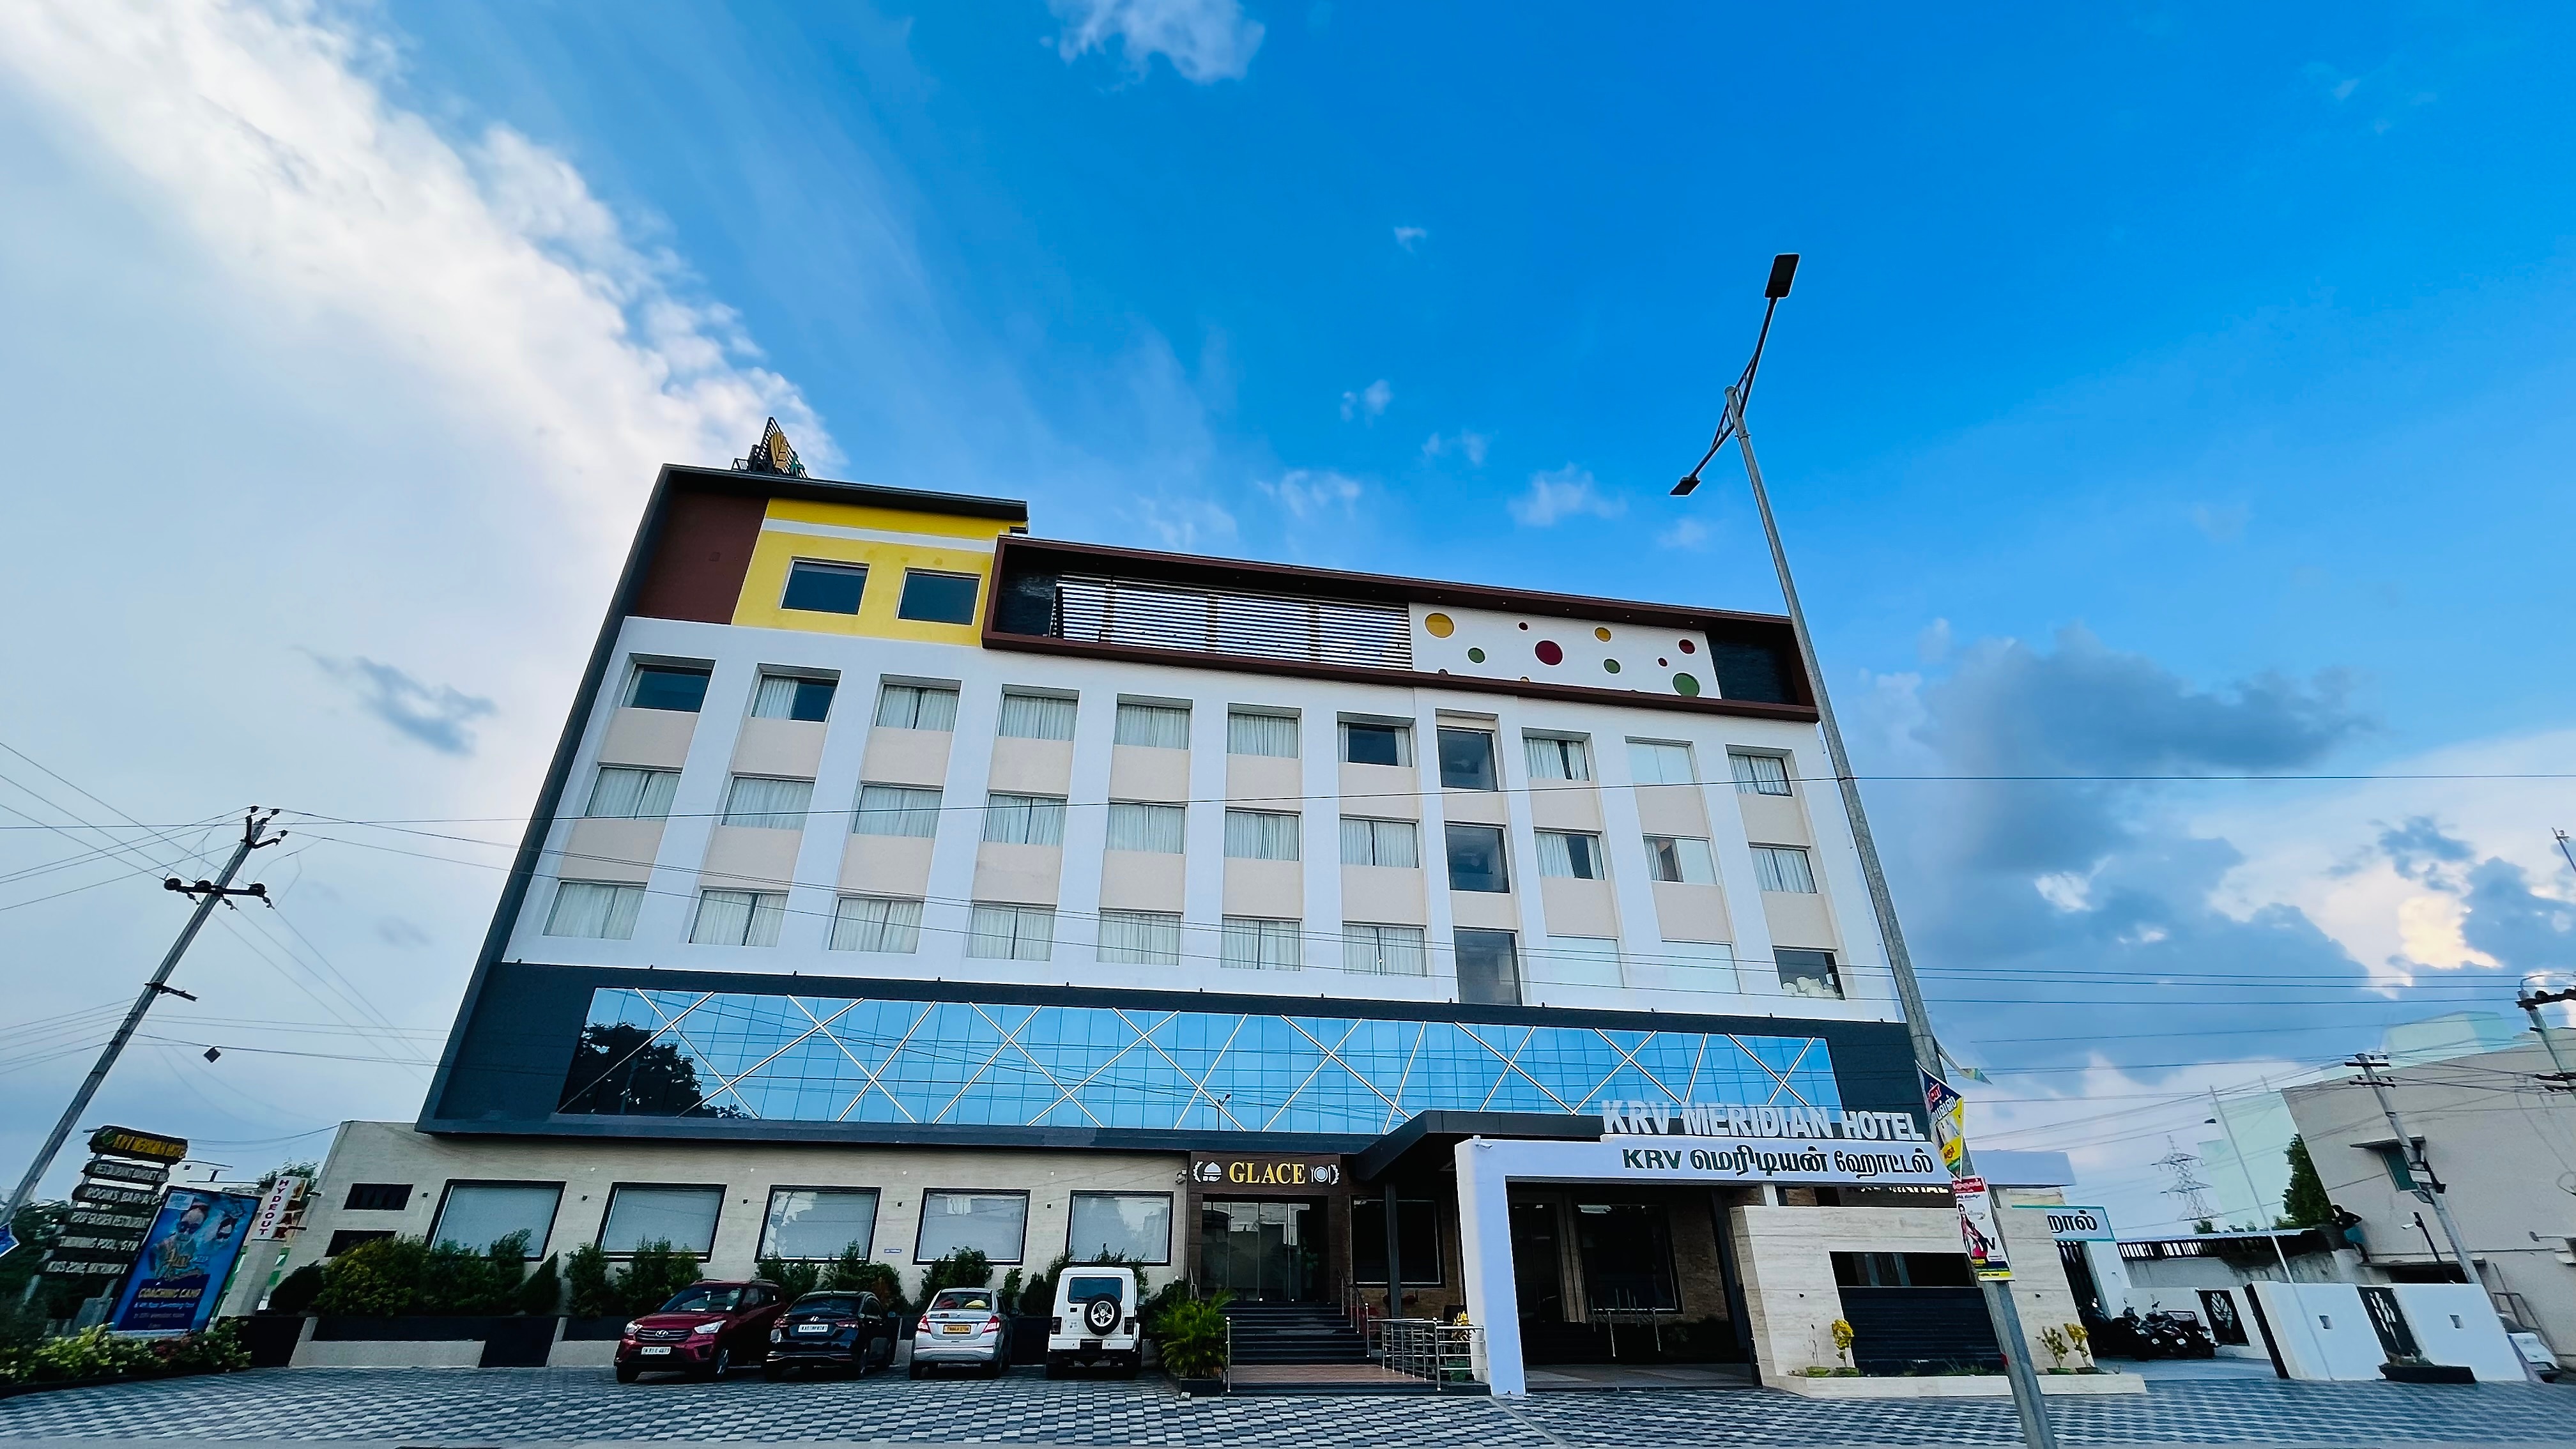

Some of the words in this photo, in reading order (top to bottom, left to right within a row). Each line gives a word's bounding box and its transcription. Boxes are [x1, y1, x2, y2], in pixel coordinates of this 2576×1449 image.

[1601, 1100, 1670, 1134] KRV
[1681, 1101, 1834, 1138] MERIDIAN
[1841, 1110, 1926, 1140] HOTEL
[1229, 1161, 1306, 1185] GLACE
[1621, 1149, 1682, 1169] KRV
[1690, 1144, 1829, 1177] மெரிடியன்
[1834, 1147, 1935, 1179] ஹோட்டல்
[258, 1179, 290, 1236] HYDEOUT
